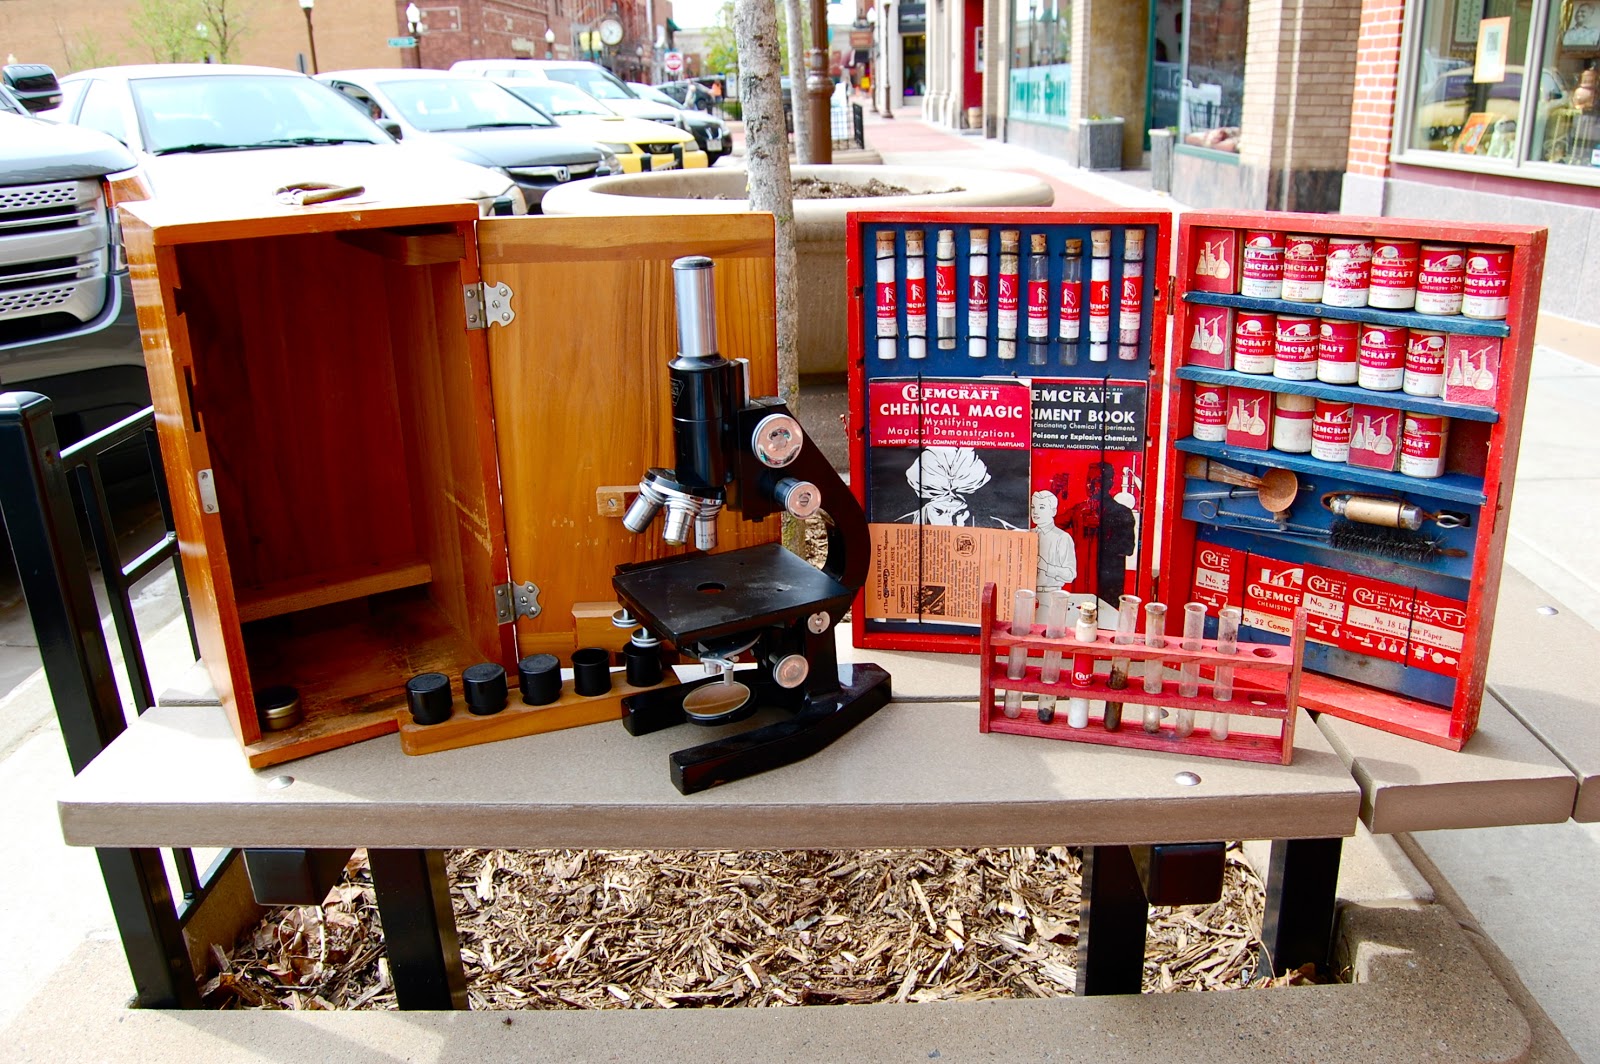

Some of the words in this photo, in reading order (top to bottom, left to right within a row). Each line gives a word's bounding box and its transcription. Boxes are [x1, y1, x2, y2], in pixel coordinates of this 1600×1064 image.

[1418, 272, 1465, 284] CHEMCRA
[901, 383, 999, 402] CHEMCRAFT
[879, 403, 960, 416] CHEMICAL
[968, 404, 1023, 419] MAGIC
[1088, 409, 1136, 424] BOOK
[923, 417, 979, 428] Mystifying
[1033, 421, 1067, 430] Fascinating
[1069, 422, 1097, 430] Chemical
[1099, 423, 1136, 432] Eperiments
[887, 426, 929, 437] Magical
[933, 427, 1015, 439] Demonstrations
[1070, 433, 1102, 441] Explosive
[1104, 434, 1138, 442] Chemicals
[1257, 600, 1292, 613] CHEMISTRY
[1309, 596, 1324, 609] No.
[1328, 602, 1338, 611] 31
[1352, 587, 1467, 629] CHEMCRAFT
[1254, 618, 1264, 626] 32
[1267, 620, 1290, 632] Congo
[1387, 619, 1396, 628] 18
[1423, 629, 1443, 641] Paper
